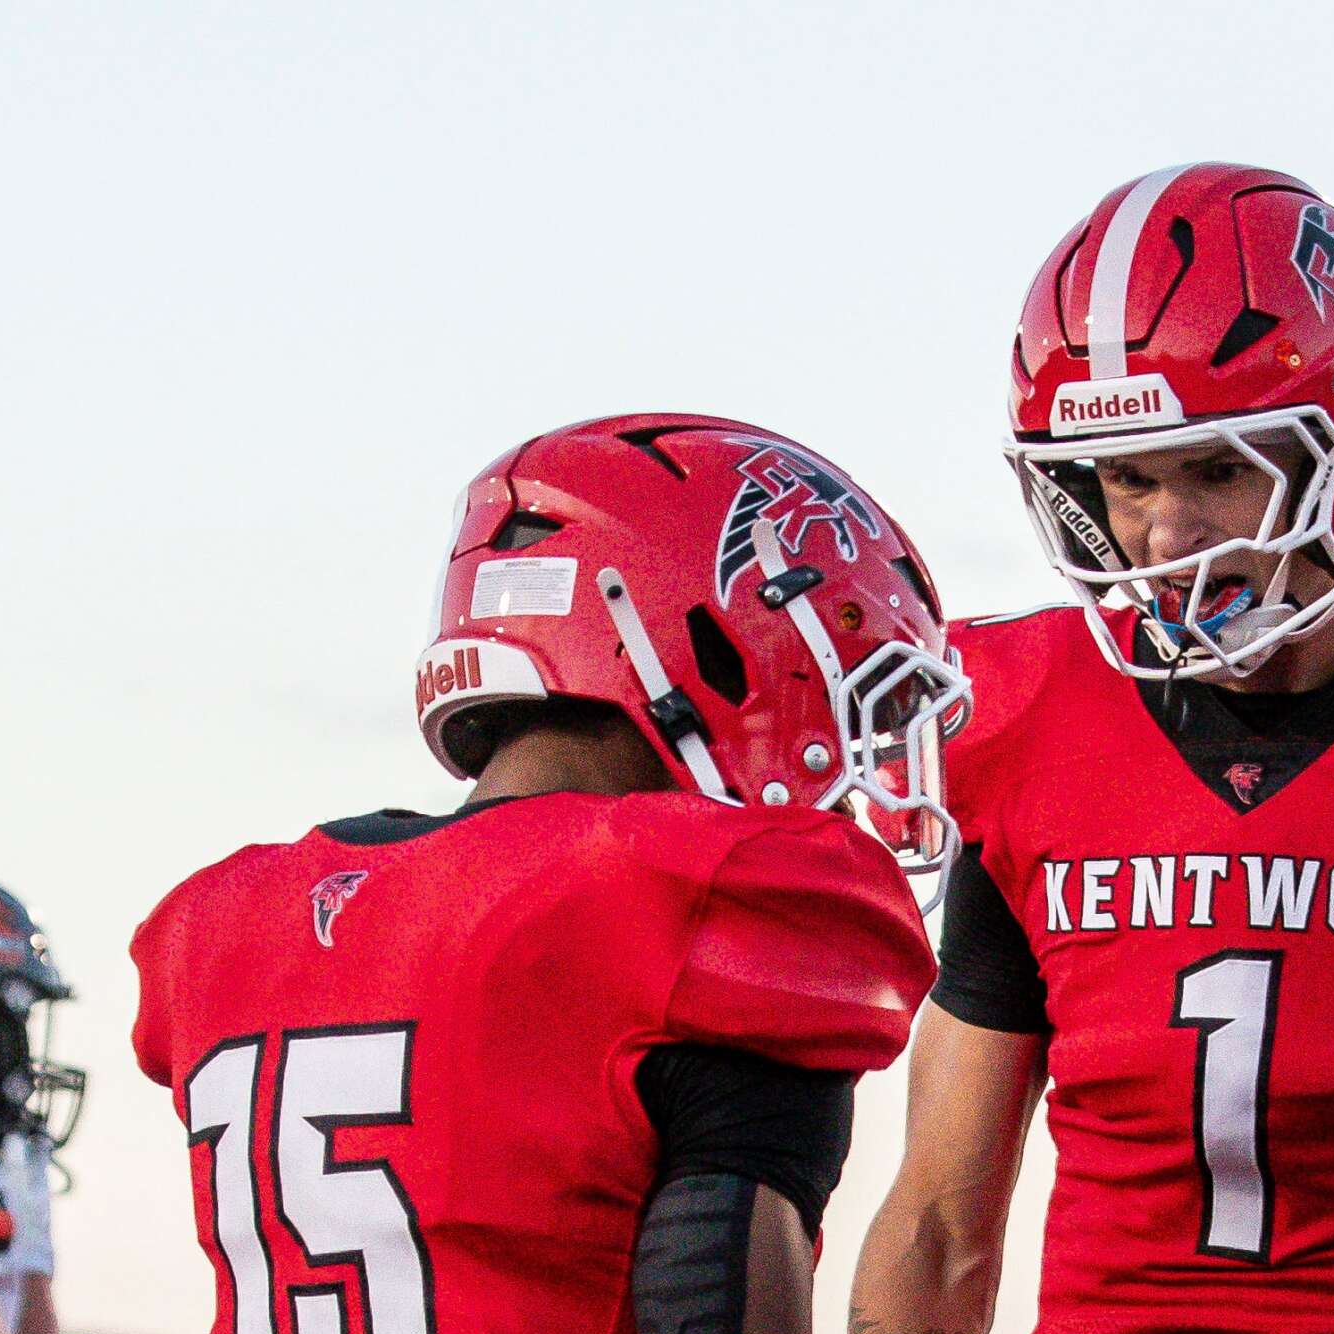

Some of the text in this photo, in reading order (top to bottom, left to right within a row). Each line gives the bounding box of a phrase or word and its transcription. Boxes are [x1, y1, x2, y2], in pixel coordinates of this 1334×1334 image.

[1058, 389, 1161, 422] Riddell
[1051, 490, 1111, 559] Riddell
[1169, 949, 1284, 1263] 1
